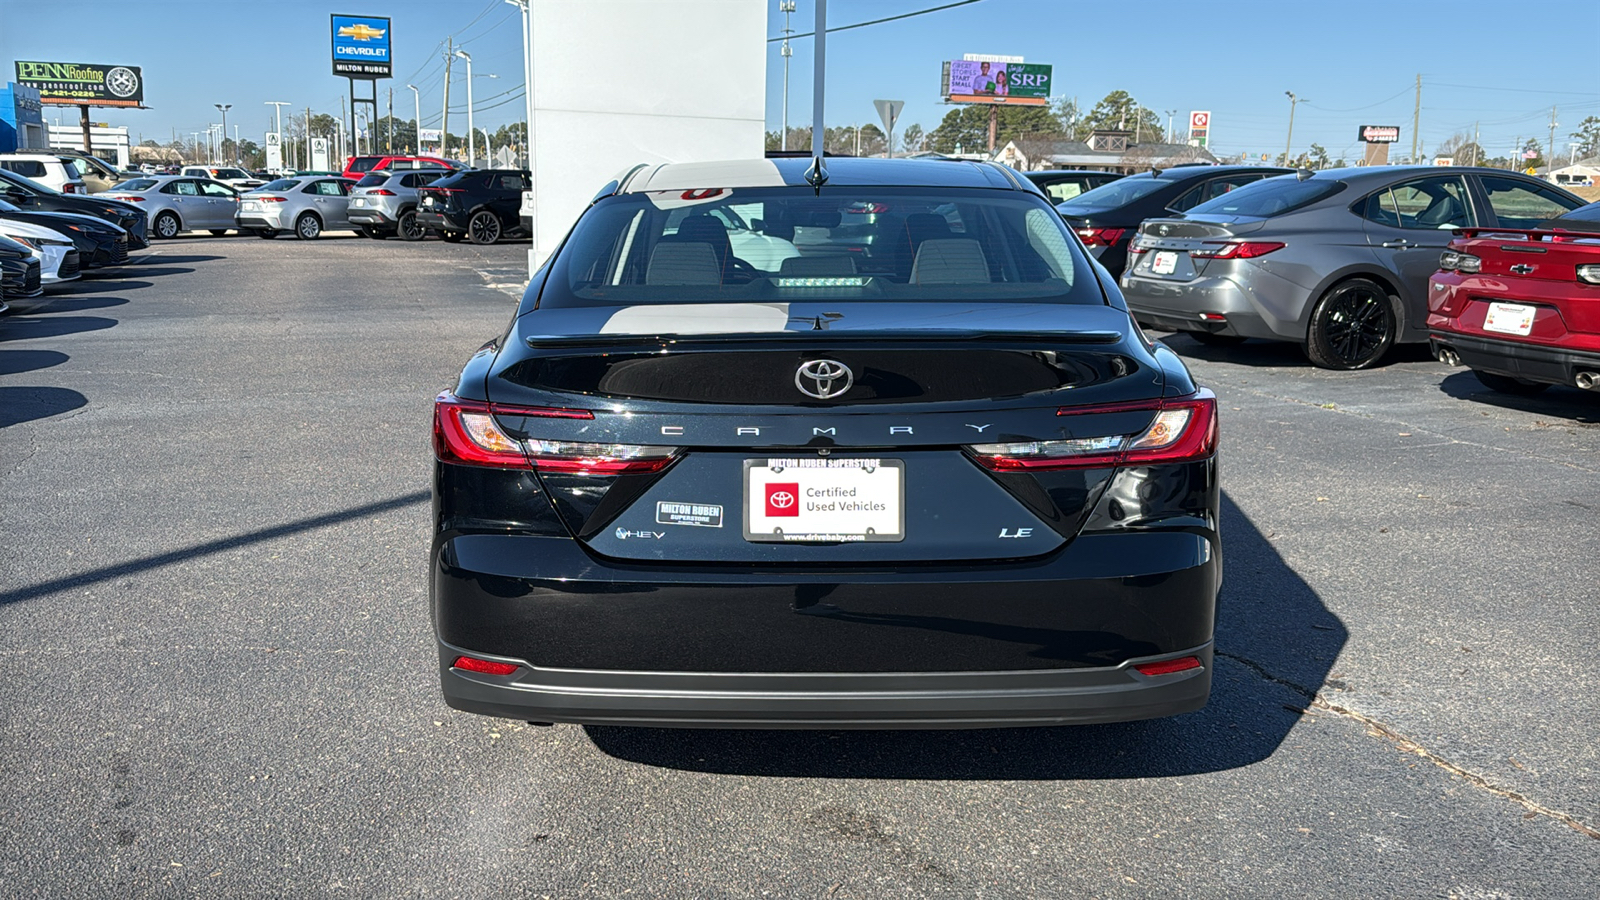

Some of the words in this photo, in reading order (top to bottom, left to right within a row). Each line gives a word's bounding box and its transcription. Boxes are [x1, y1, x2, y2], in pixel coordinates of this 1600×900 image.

[337, 46, 386, 56] CHEVROLET
[18, 62, 71, 79] PENN
[70, 66, 104, 83] Roofing
[336, 64, 362, 72] MILTON
[1010, 73, 1048, 86] SRP
[661, 423, 993, 436] CAMRY
[768, 459, 798, 468] MILTON
[799, 459, 827, 468] RUBEN
[828, 459, 881, 468] SUPERSTORE
[806, 487, 857, 497] Certified
[661, 503, 692, 515] MILTON
[692, 505, 720, 517] RUBEN
[806, 502, 836, 512] Used
[838, 501, 886, 512] Vehicles
[670, 514, 710, 523] SUPERSTORE
[783, 533, 866, 543] www.drivebaby.com
[999, 527, 1034, 539] LE
